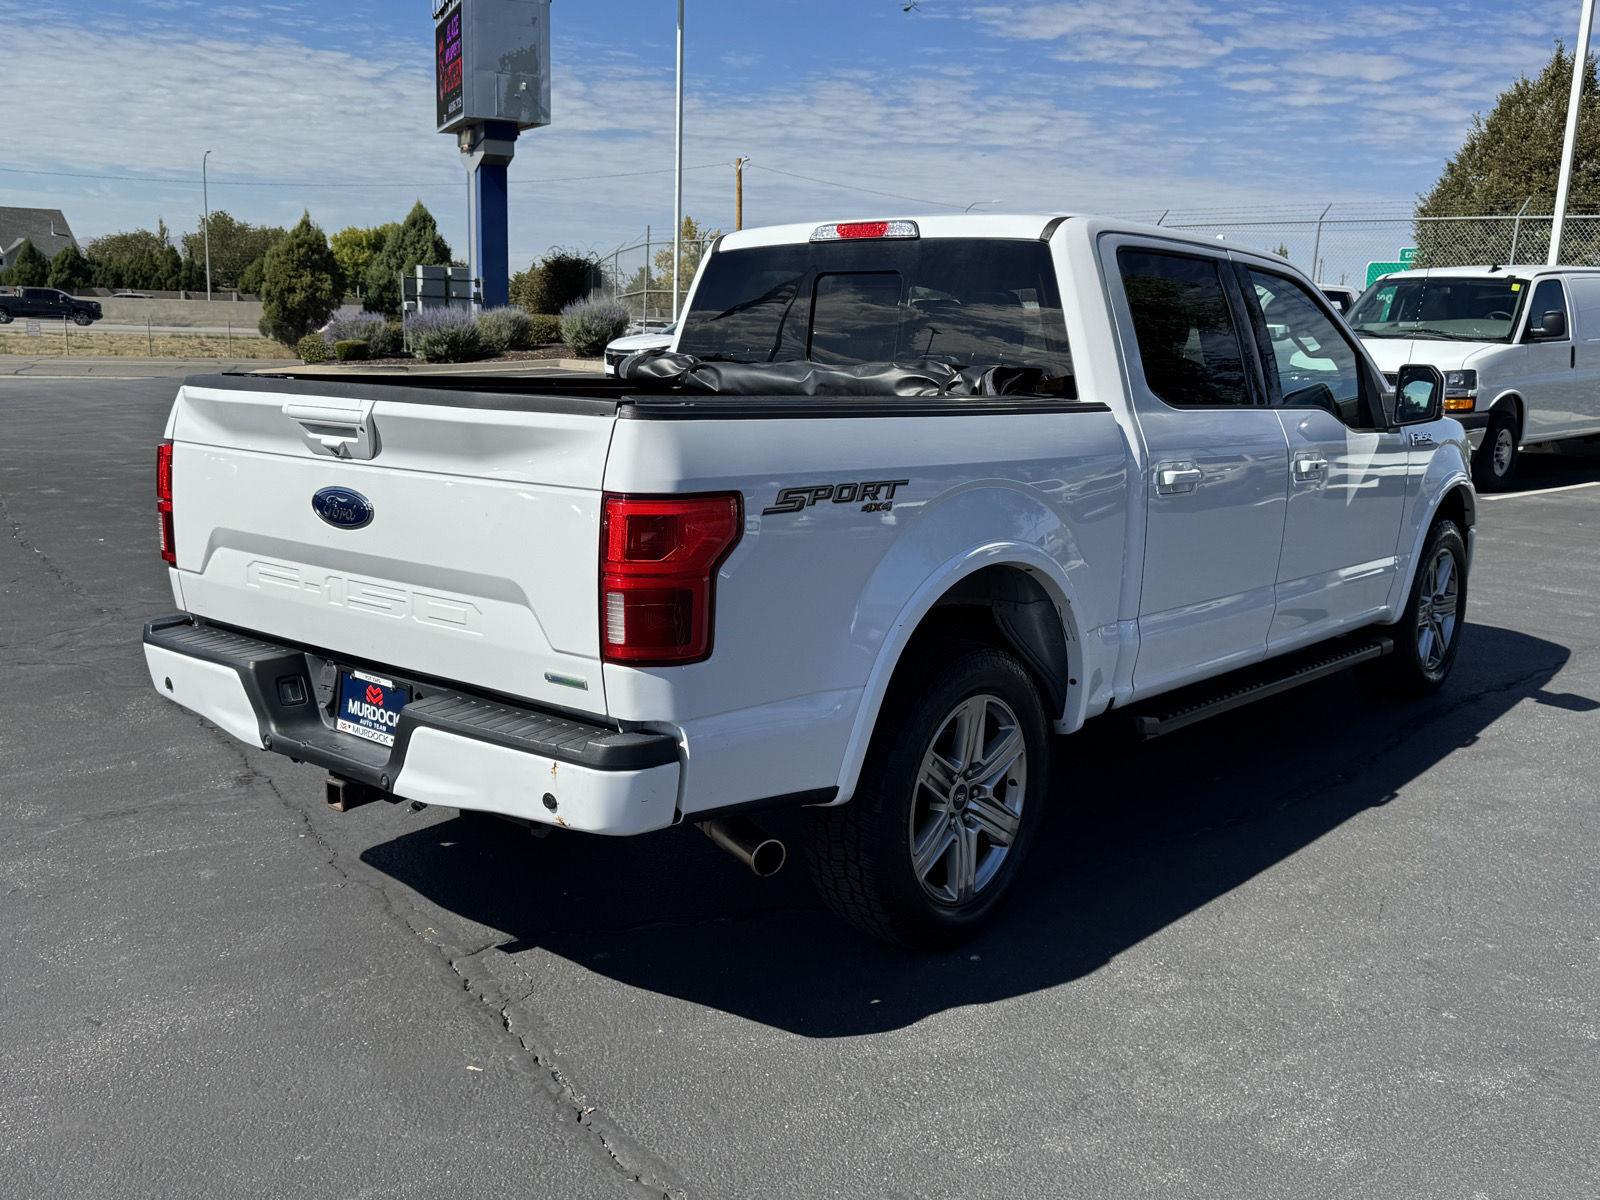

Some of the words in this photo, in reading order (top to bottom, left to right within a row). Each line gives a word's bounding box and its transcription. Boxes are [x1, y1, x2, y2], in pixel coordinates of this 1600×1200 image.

[324, 495, 357, 521] Ford
[762, 479, 910, 516] SPORT
[246, 560, 483, 637] F-150
[348, 699, 400, 727] MURDOCK
[360, 718, 373, 727] AUTO
[373, 723, 387, 732] TEAM
[352, 725, 389, 744] MURDOCK
